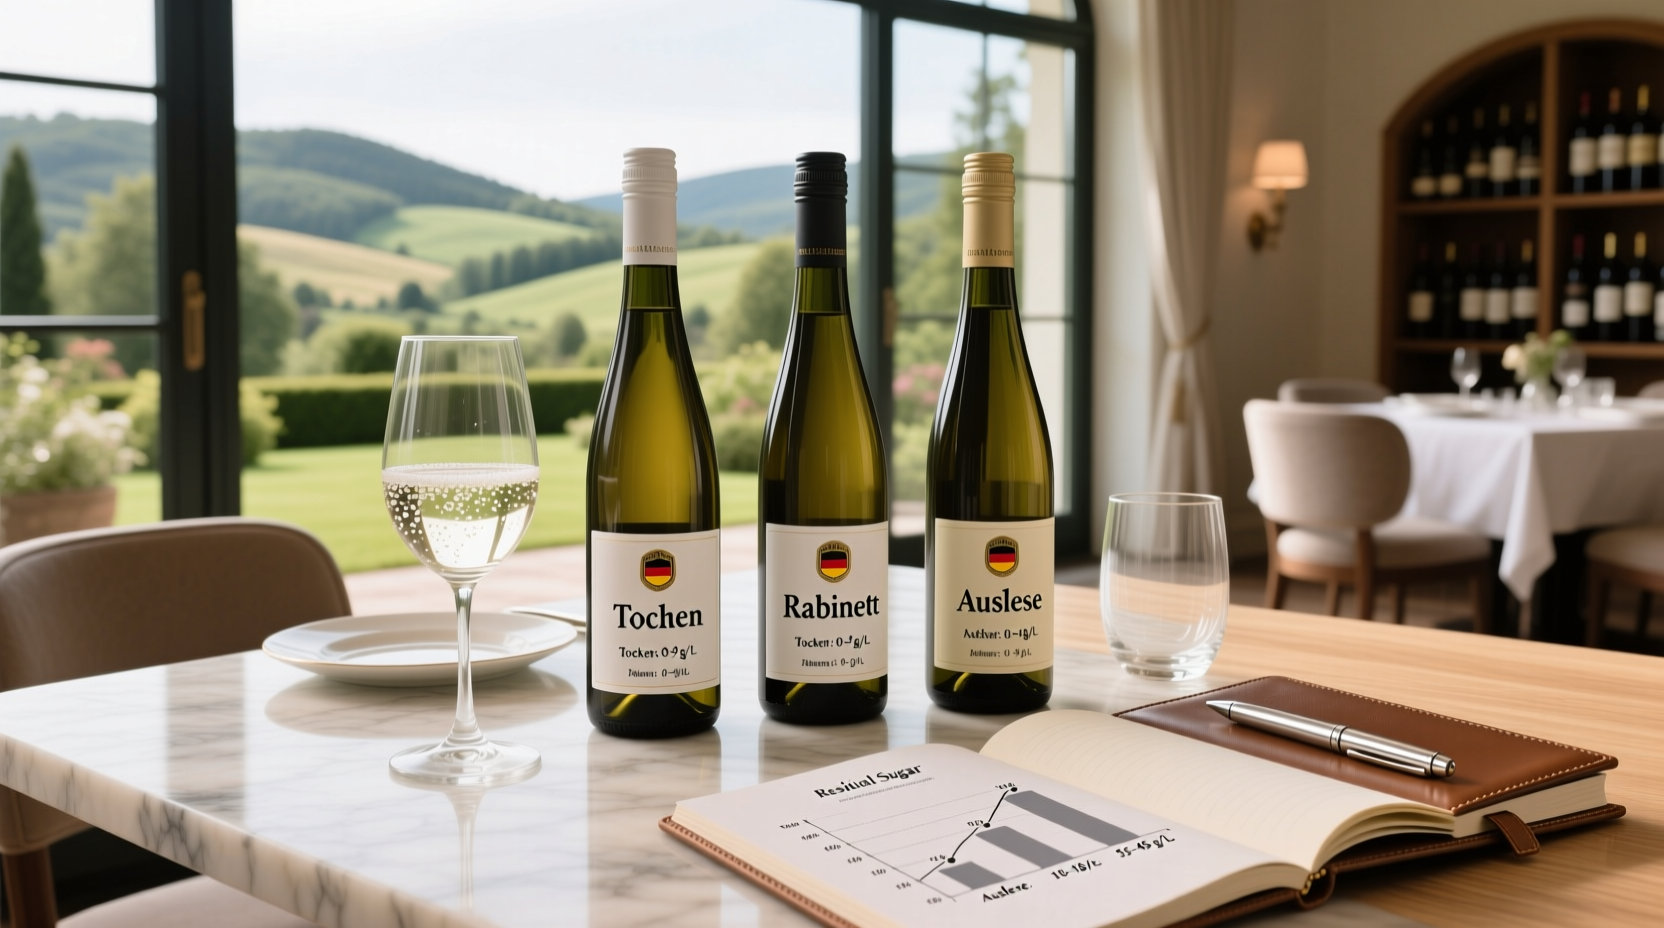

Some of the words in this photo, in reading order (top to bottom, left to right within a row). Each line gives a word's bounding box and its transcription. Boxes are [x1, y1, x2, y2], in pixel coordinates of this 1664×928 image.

[783, 594, 880, 619] Rabinett
[956, 588, 1042, 612] Auslese
[613, 603, 703, 630] Tochen
[876, 765, 922, 782] Sugar
